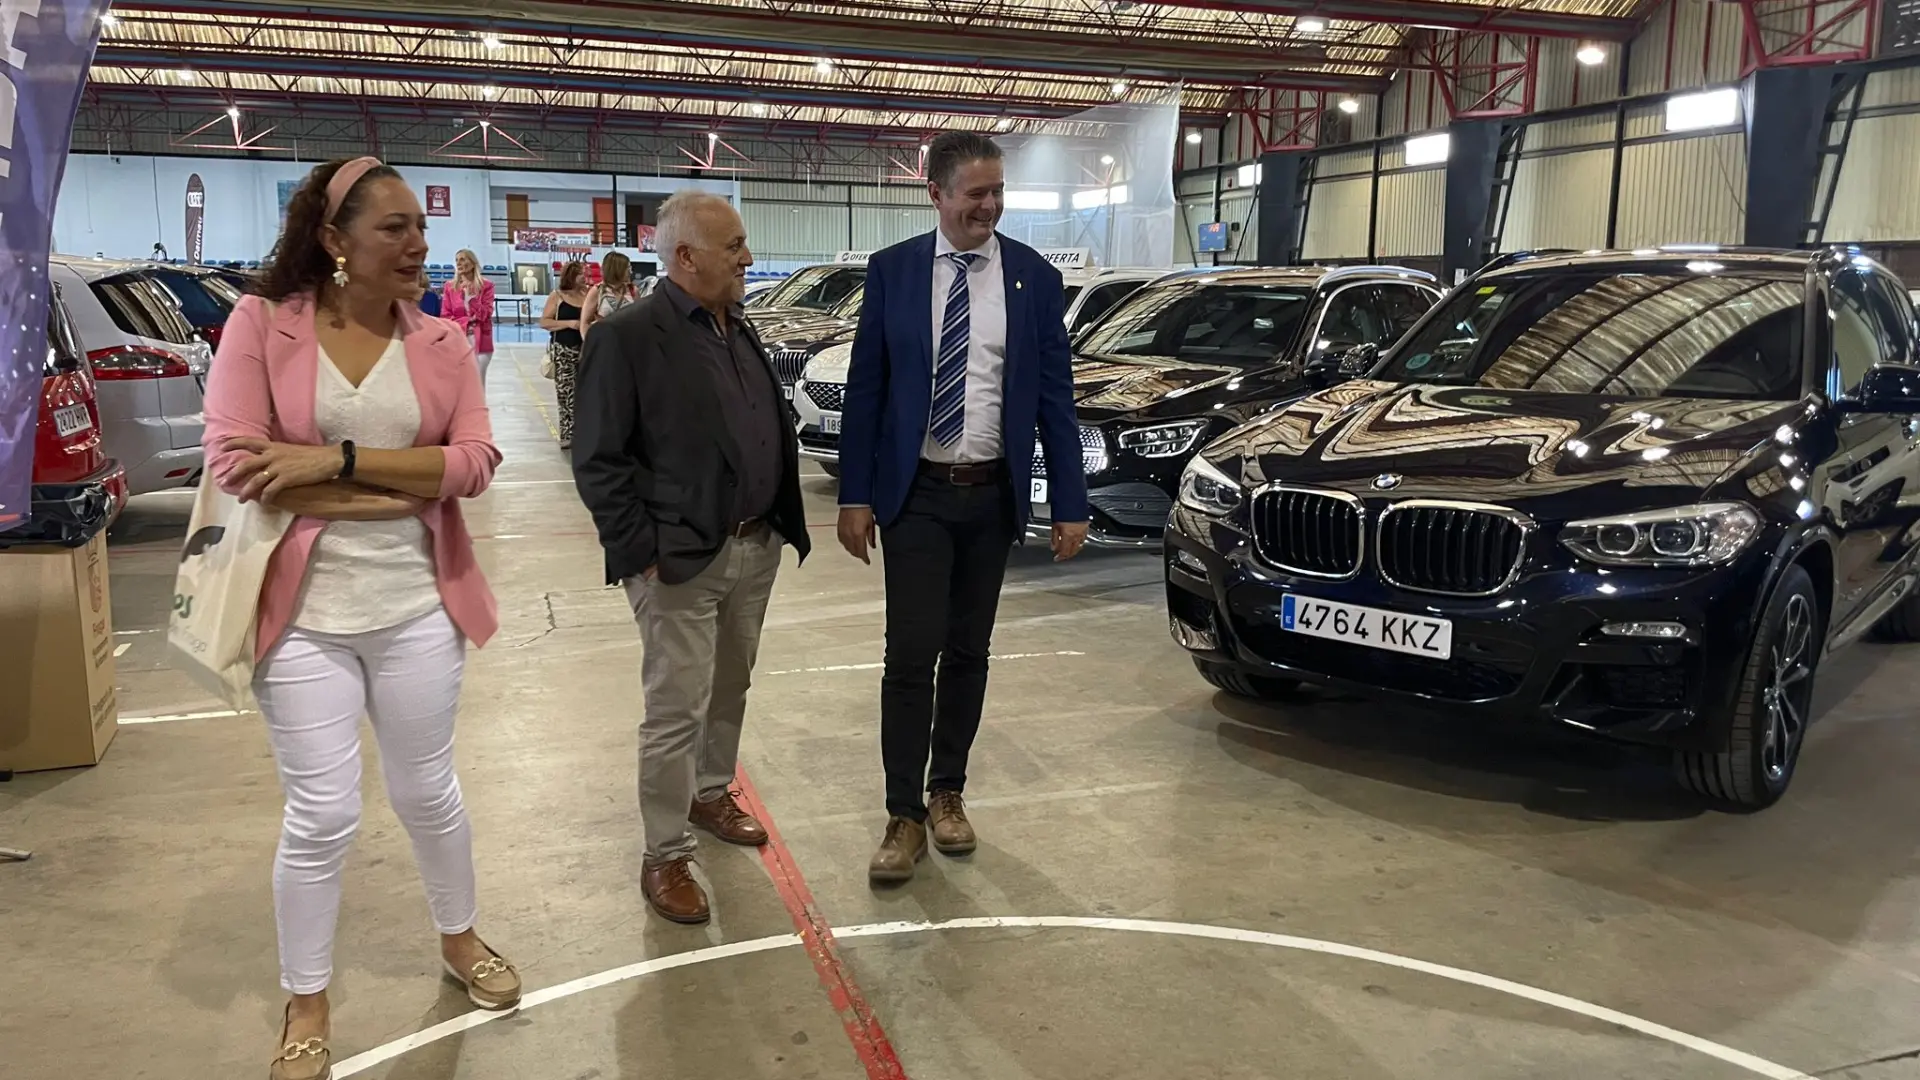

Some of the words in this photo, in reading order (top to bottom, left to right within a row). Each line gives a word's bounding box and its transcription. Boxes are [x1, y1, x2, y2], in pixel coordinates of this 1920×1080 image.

[193, 216, 203, 260] Dalmau
[850, 253, 869, 261] OFER
[826, 418, 841, 432] 189
[1298, 602, 1369, 639] 4764
[1381, 615, 1441, 651] KKZ
